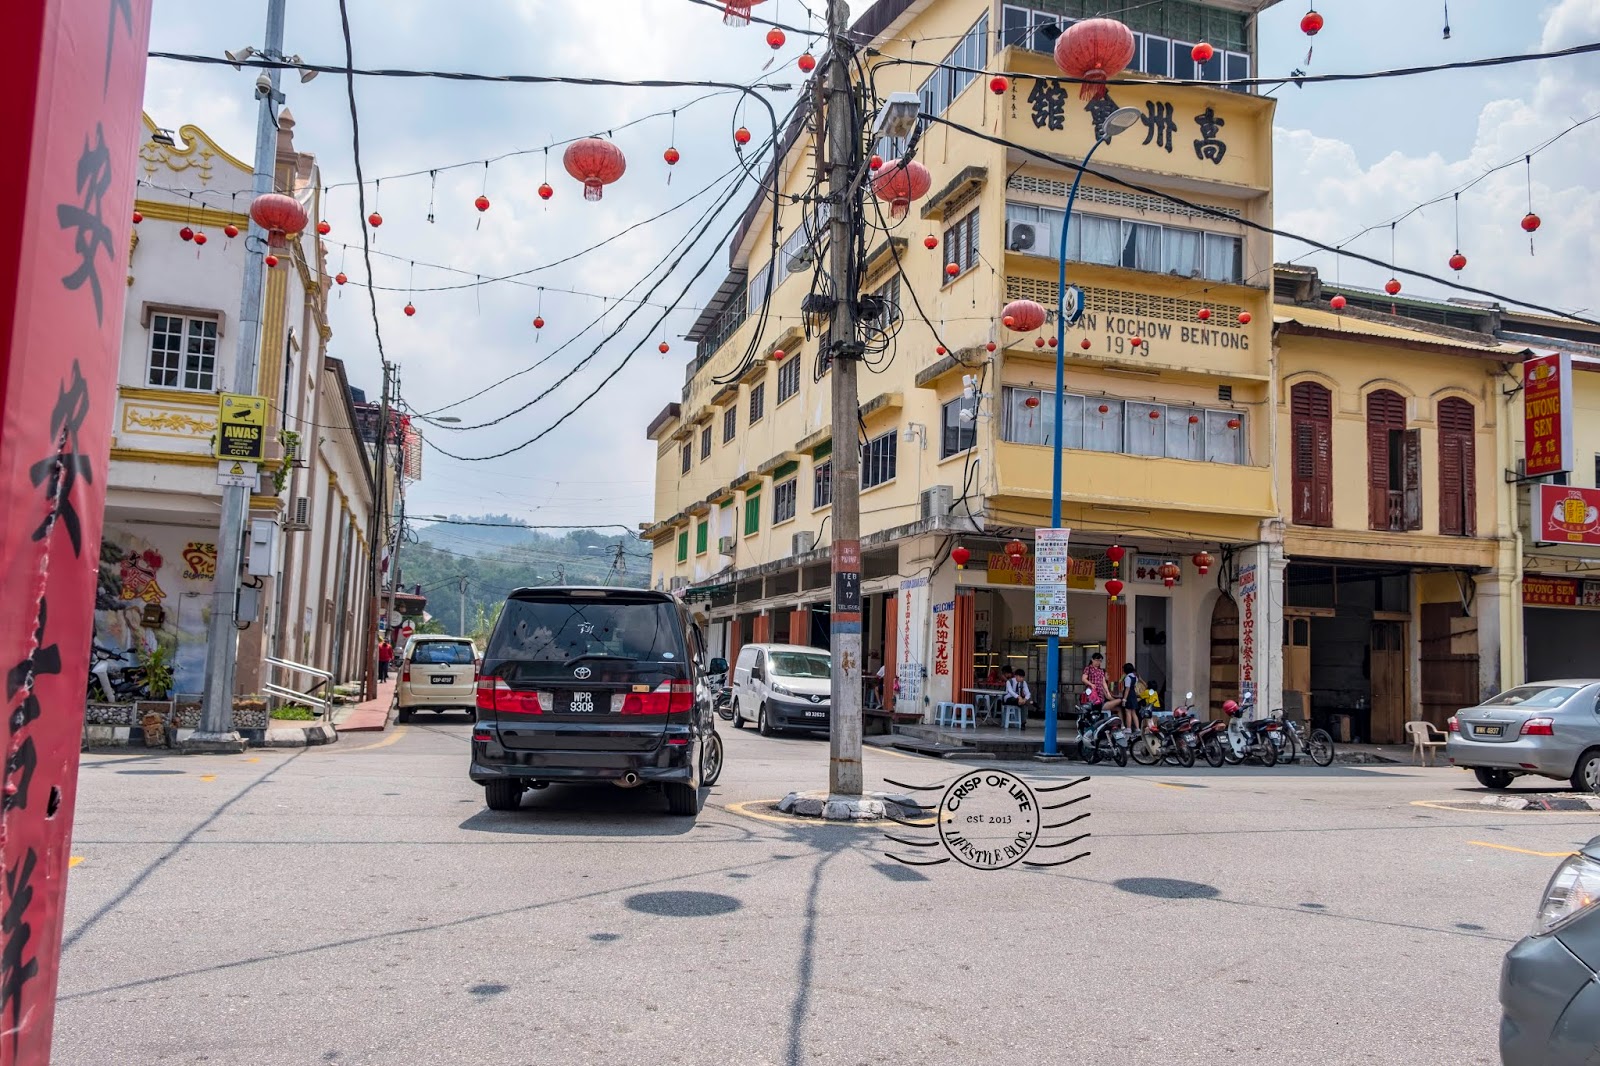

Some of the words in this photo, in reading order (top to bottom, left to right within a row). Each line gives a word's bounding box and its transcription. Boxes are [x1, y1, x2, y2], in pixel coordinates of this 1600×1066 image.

[1106, 316, 1172, 340] KOCHOW
[1181, 326, 1249, 350] BENTONG
[1526, 396, 1559, 419] KWONG
[225, 425, 259, 440] AWAS
[1533, 417, 1553, 438] SEN
[230, 448, 250, 456] CCTV
[1522, 583, 1554, 594] KWONG
[1556, 586, 1575, 595] SEN
[933, 601, 956, 613] WELCOME
[573, 691, 592, 702] WPR
[570, 701, 594, 712] 9308
